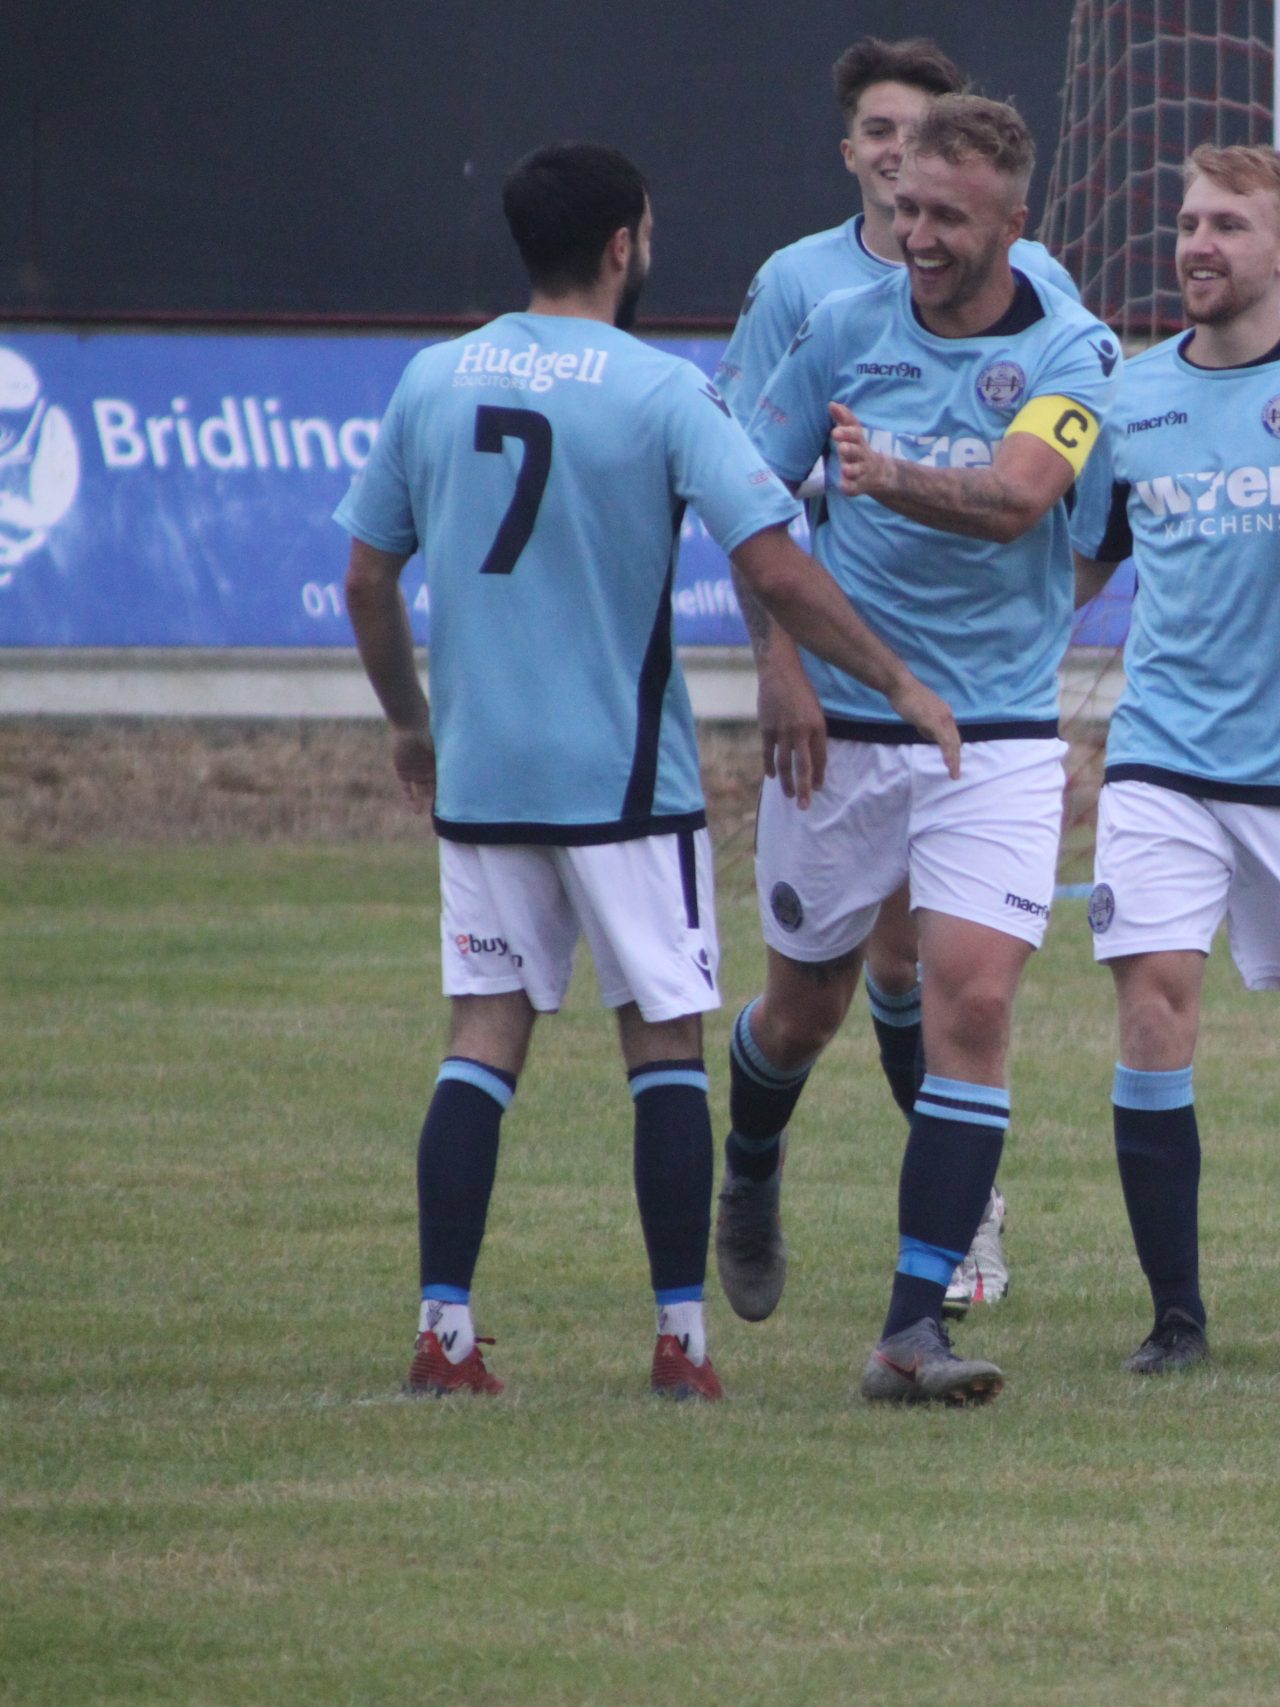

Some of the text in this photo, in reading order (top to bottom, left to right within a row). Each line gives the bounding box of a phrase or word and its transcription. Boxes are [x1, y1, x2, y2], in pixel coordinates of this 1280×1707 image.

[454, 342, 609, 393] Hudgell
[856, 362, 921, 380] macron
[1053, 408, 1089, 449] C
[1127, 411, 1188, 434] macron
[474, 404, 553, 575] 7
